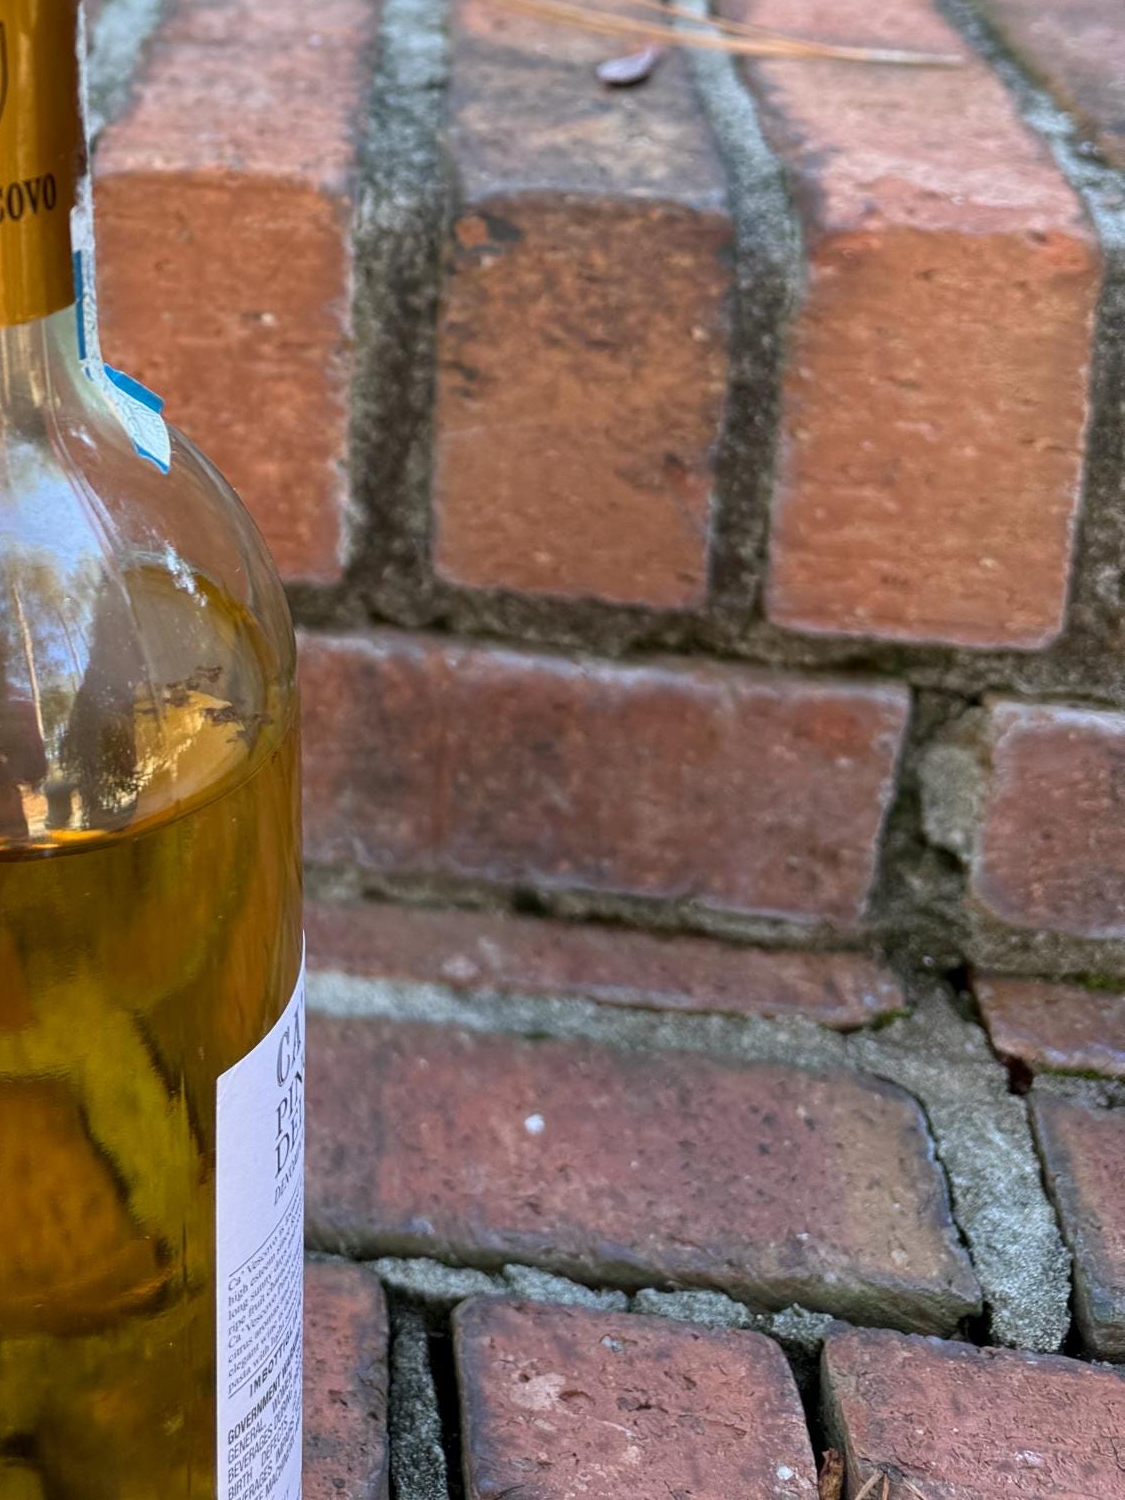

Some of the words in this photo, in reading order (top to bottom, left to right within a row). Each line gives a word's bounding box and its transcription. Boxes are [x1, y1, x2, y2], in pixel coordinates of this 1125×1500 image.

[276, 1003, 303, 1087] CA
[227, 1372, 280, 1445] GOVERNMENT
[228, 1421, 272, 1484] BEVERAGES
[228, 1467, 252, 1500] BIRTH
[239, 1458, 272, 1500] VERAGES
